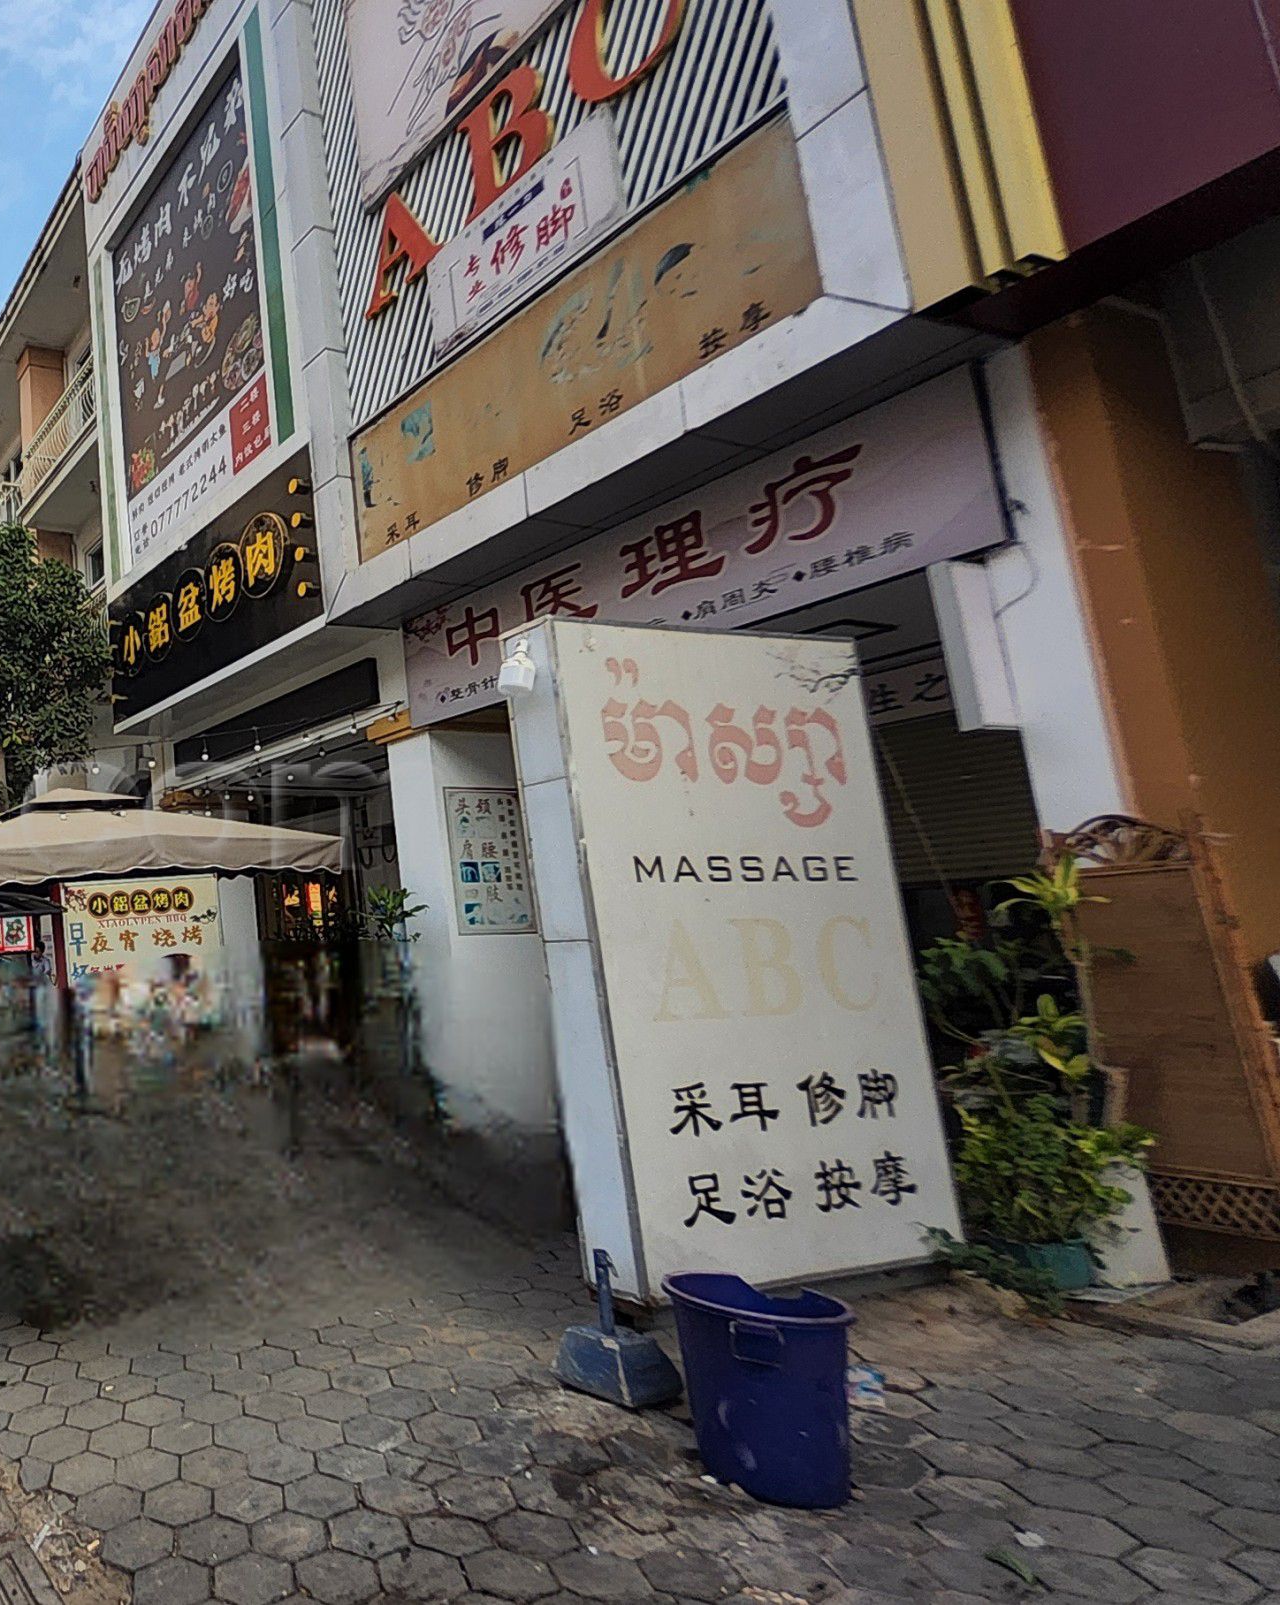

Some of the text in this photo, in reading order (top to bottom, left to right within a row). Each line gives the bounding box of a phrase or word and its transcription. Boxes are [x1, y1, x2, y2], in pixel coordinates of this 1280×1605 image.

[491, 203, 576, 275] 修脚
[386, 510, 420, 546] 采耳
[568, 388, 624, 436] 足浴
[698, 300, 772, 360] 按摩
[445, 443, 863, 667] 中医理疗
[693, 580, 780, 620] 肩周炎
[810, 531, 916, 581] 腰椎病
[633, 855, 859, 883] MASSAGE
[90, 924, 203, 954] 夜宵 烧烤
[653, 915, 877, 1022] ABC
[670, 1068, 899, 1137] 采耳 修脚
[683, 1150, 918, 1228] 足浴 按摩
